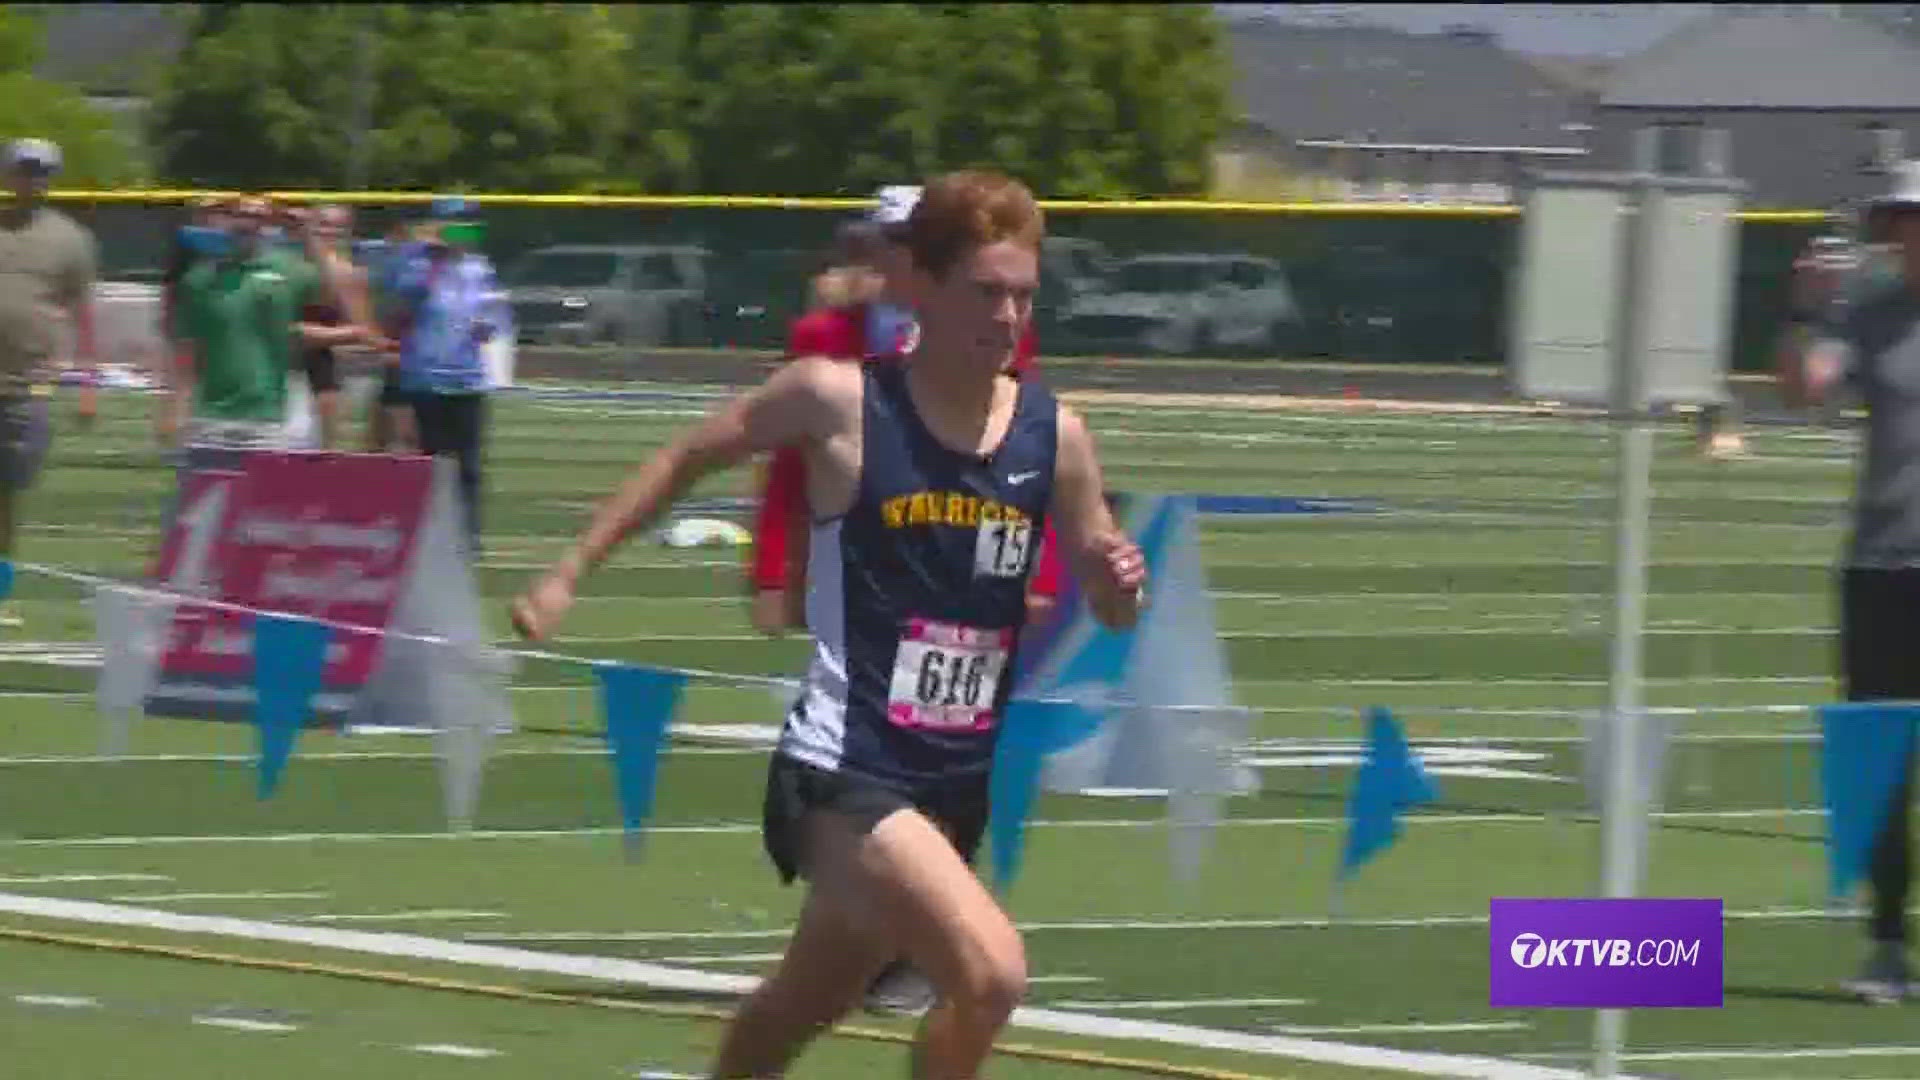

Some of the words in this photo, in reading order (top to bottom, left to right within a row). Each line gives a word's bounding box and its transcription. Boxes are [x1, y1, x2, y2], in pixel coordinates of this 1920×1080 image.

[881, 491, 1028, 528] WARRIO
[990, 524, 1030, 573] 15
[916, 650, 987, 706] 616
